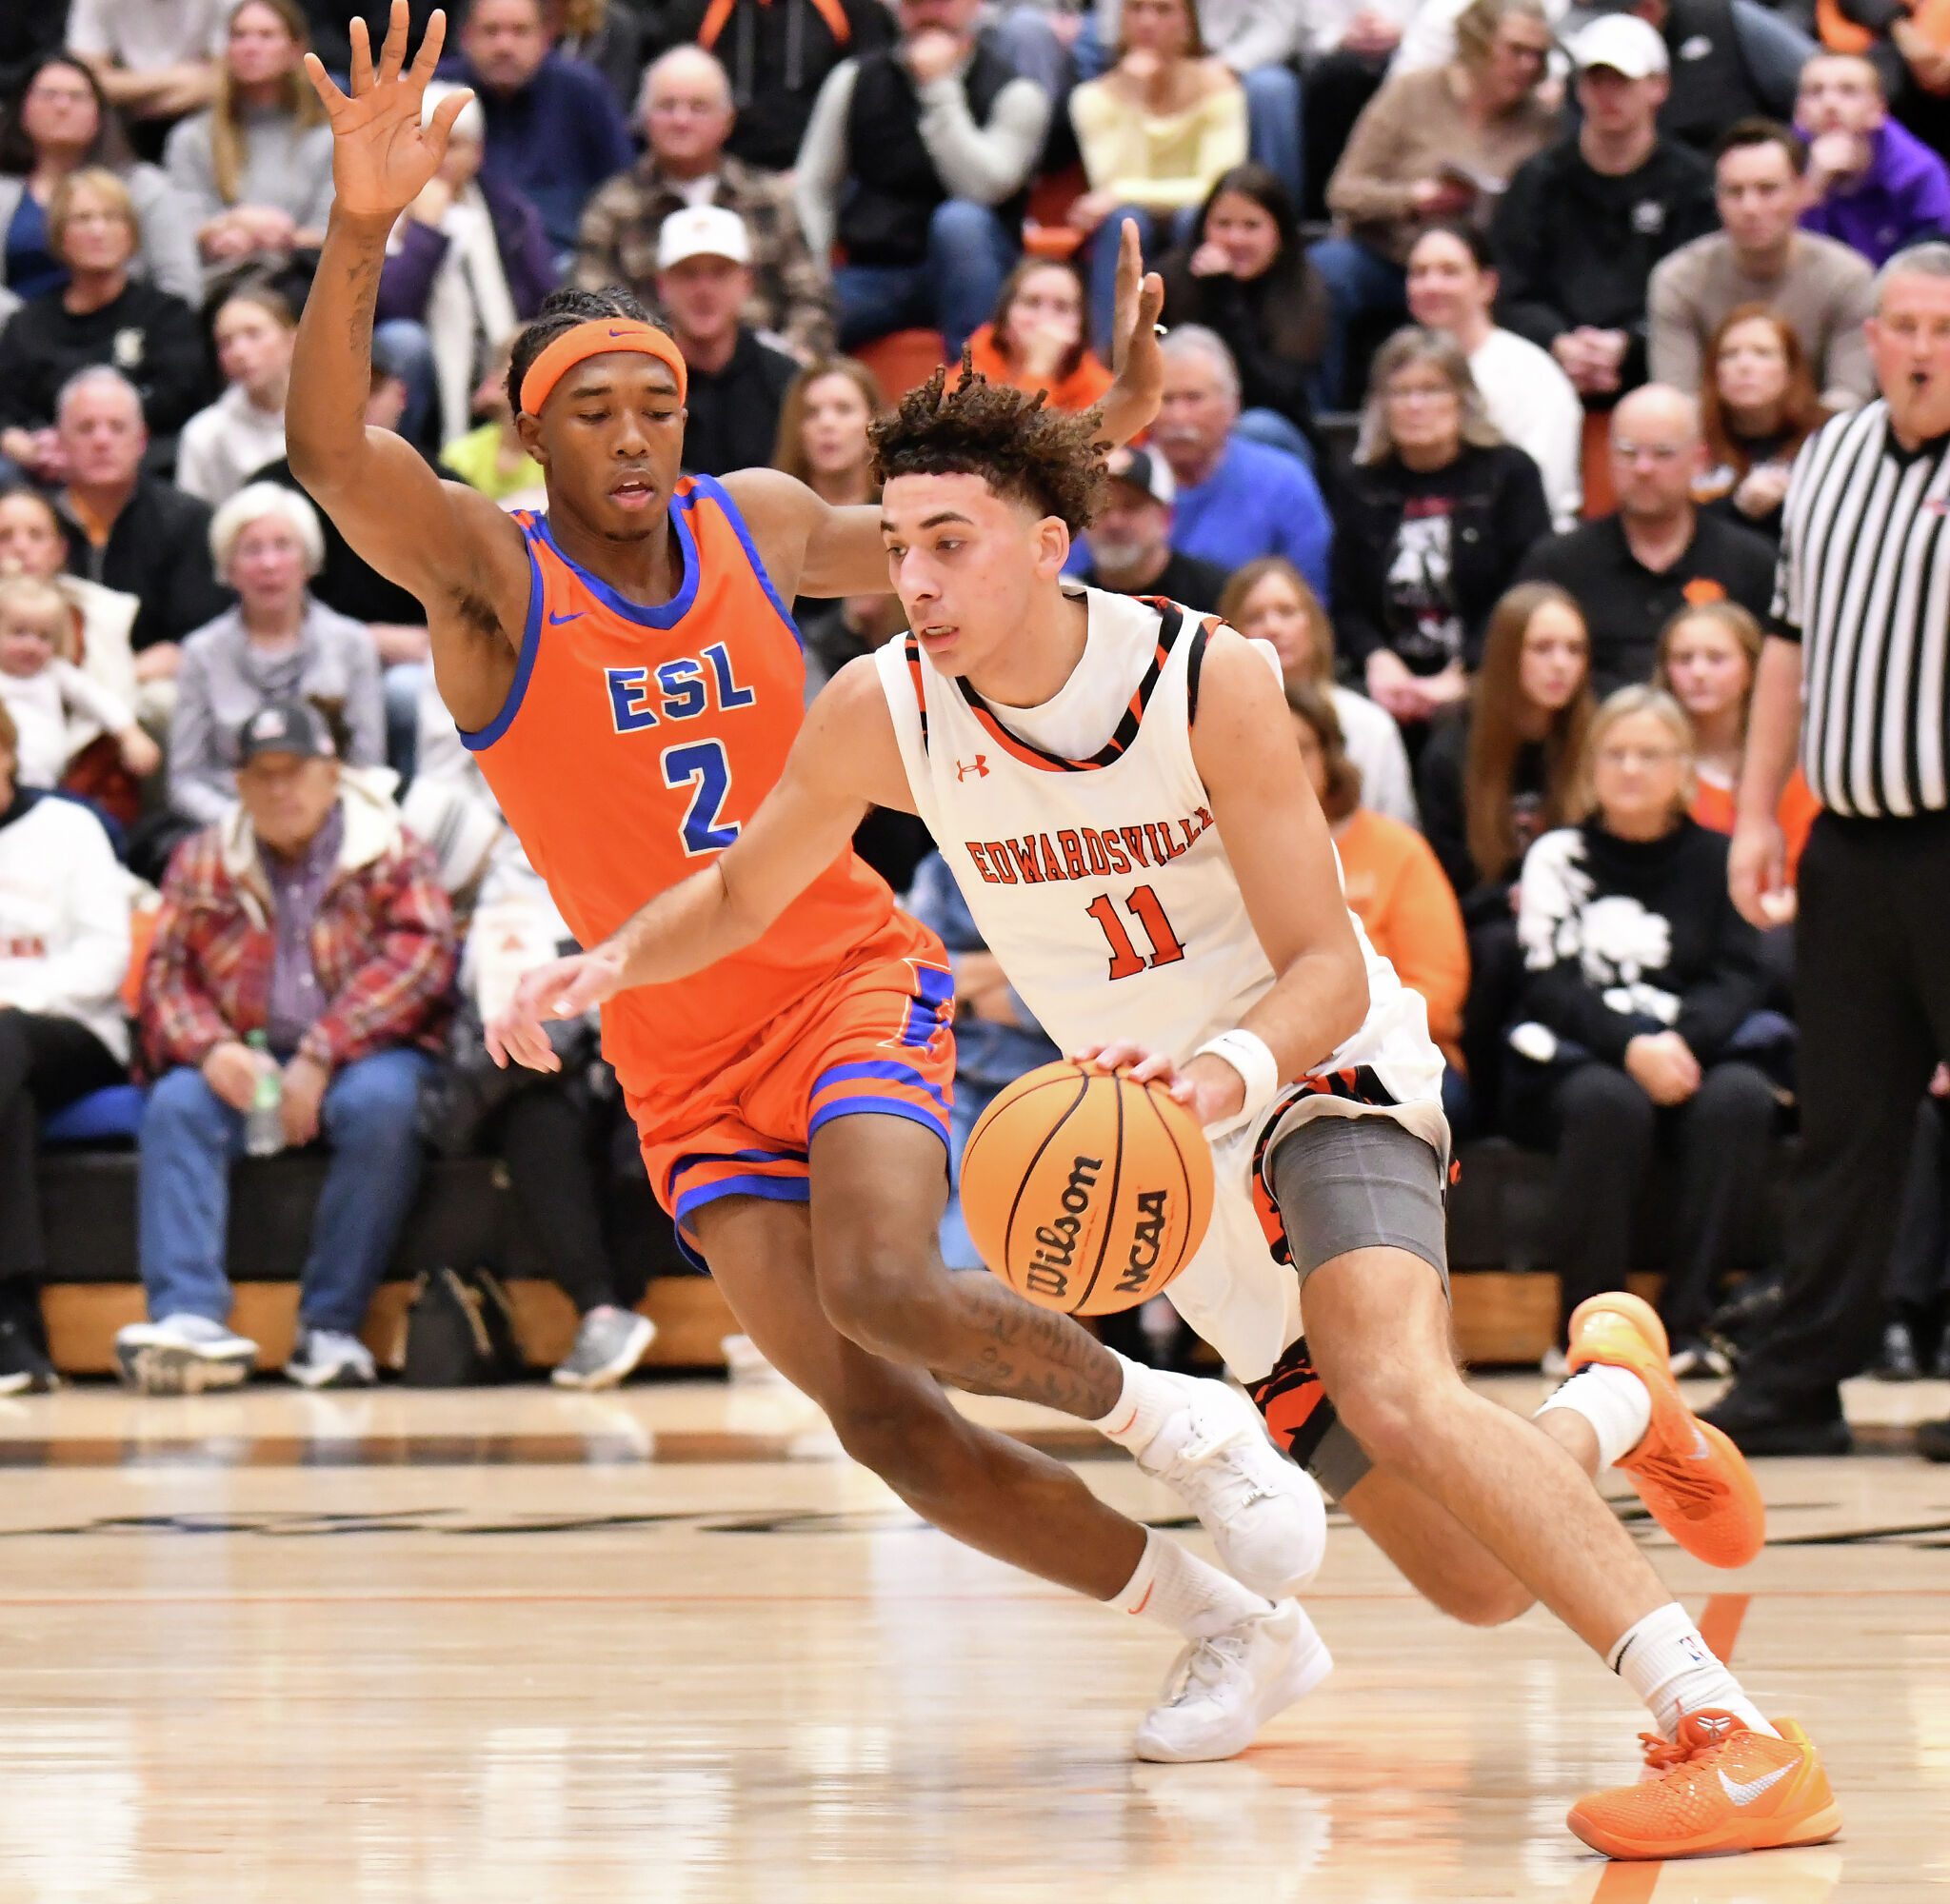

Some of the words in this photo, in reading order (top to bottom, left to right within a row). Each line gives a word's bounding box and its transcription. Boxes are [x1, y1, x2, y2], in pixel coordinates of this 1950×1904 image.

[604, 641, 756, 734] ESL
[660, 737, 743, 858] 2
[1084, 884, 1186, 981] 11
[1026, 1156, 1104, 1297] Wilson
[1113, 1188, 1167, 1293] NCAA
